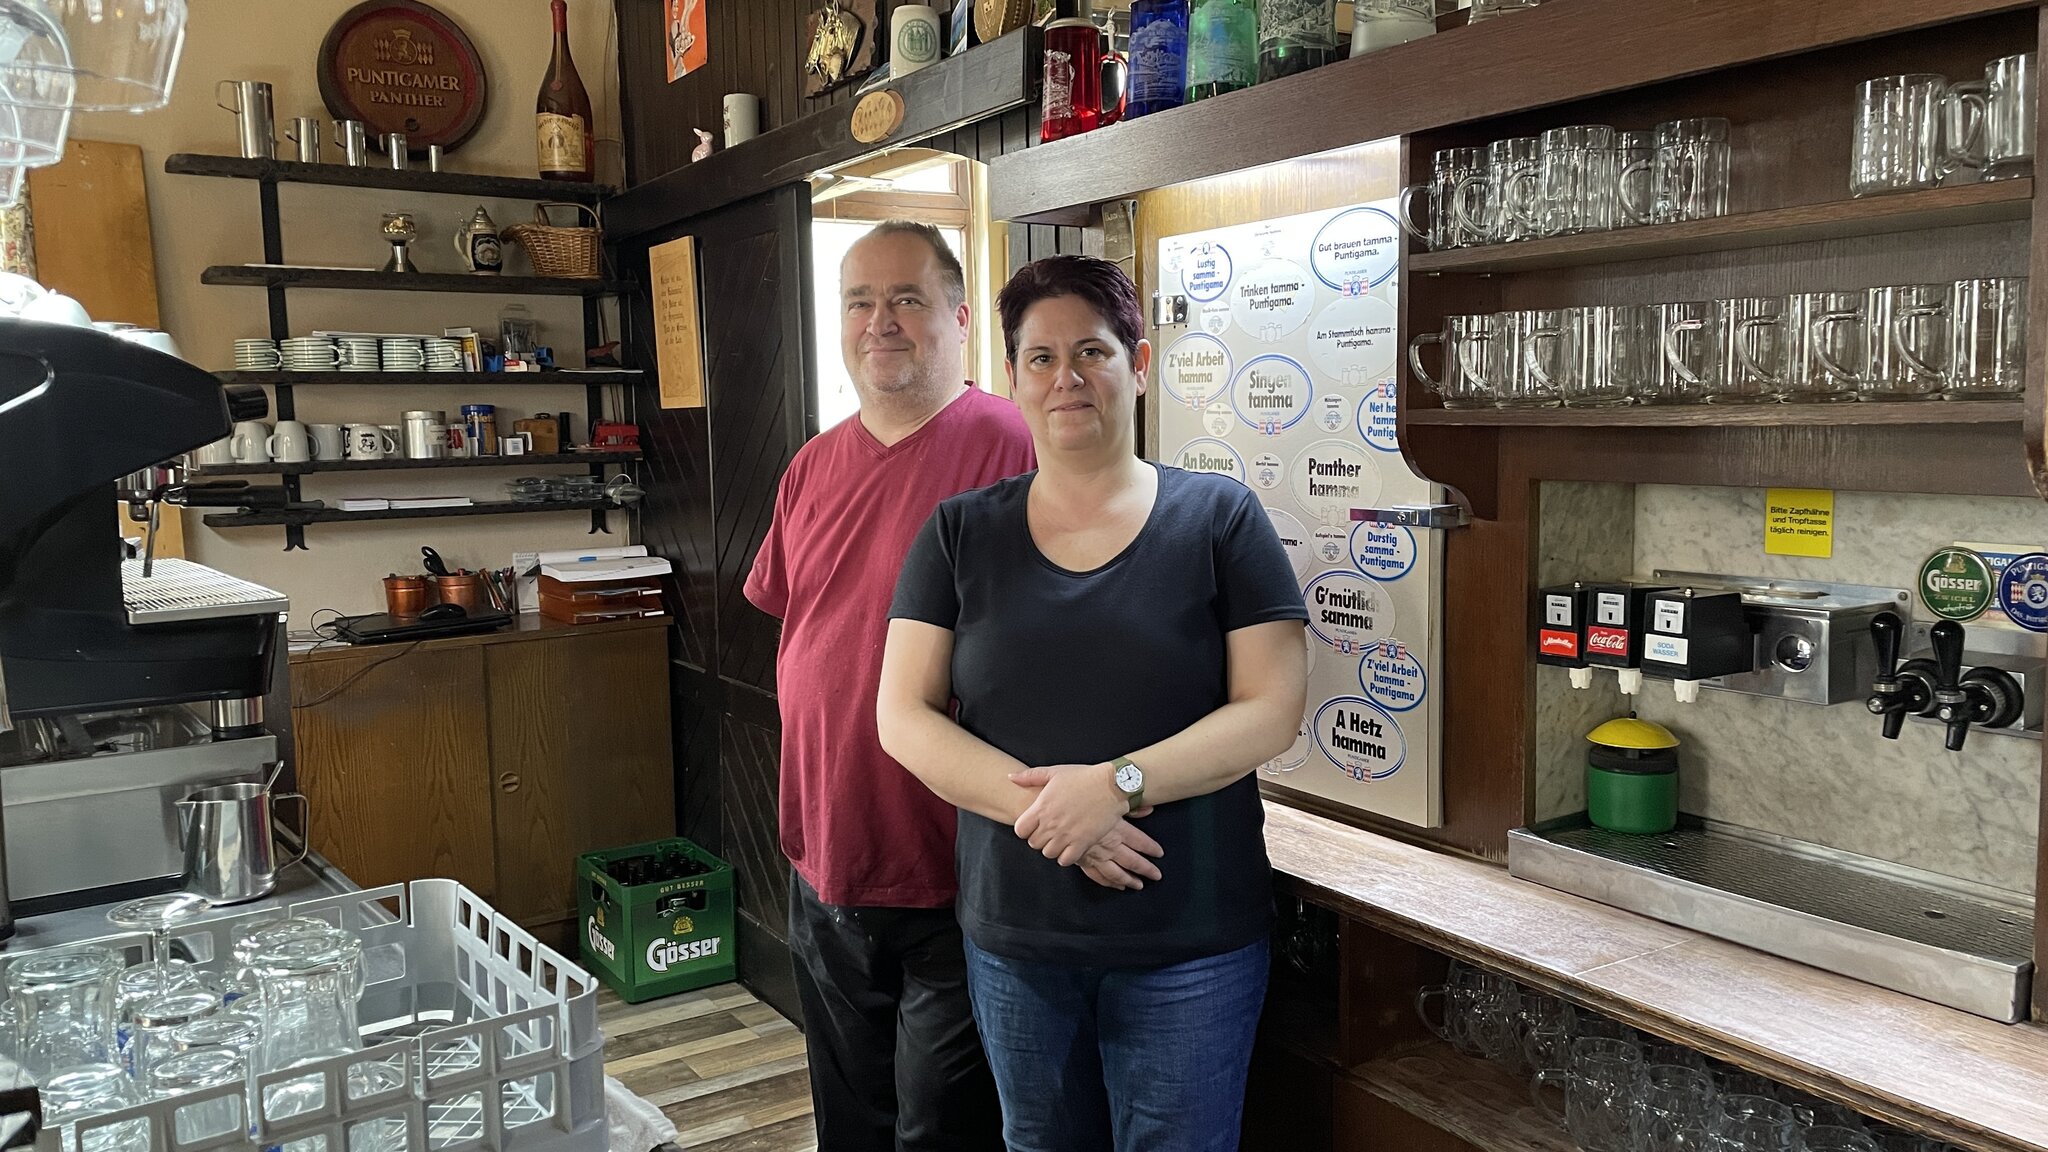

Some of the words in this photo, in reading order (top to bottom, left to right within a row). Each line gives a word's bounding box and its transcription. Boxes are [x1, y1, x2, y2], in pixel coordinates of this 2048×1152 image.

[347, 67, 461, 91] PUNTIGAMER
[370, 90, 444, 107] PANTHER
[1318, 243, 1332, 252] Gut
[1333, 240, 1361, 250] brauen
[1363, 236, 1392, 246] tamma
[1334, 248, 1380, 260] Puntigama.
[1197, 258, 1216, 270] Lustig
[1193, 271, 1216, 280] samma
[1189, 280, 1224, 292] Puntigama
[1240, 283, 1269, 298] Trinken
[1270, 282, 1299, 294] tamma
[1249, 295, 1294, 311] Puntigama.
[1316, 331, 1327, 340] Am
[1328, 326, 1364, 339] Stammtisch
[1365, 326, 1391, 336] hamma
[1336, 337, 1374, 350] Puntigama.
[1169, 351, 1194, 368] Z'viel
[1196, 350, 1224, 367] Arbeit
[1178, 368, 1213, 384] hamma
[1249, 369, 1292, 394] Singen
[1248, 391, 1293, 409] tamma
[1369, 402, 1384, 413] Net
[1367, 426, 1398, 440] Puntig
[1183, 452, 1198, 470] An
[1200, 453, 1233, 471] Bonus
[1308, 458, 1361, 477] Panther
[1309, 478, 1359, 498] hamma
[1771, 506, 1788, 514] Bitte
[1789, 507, 1830, 516] Zapfhähne
[1788, 516, 1826, 526] Tropftasse
[1368, 532, 1397, 547] Durstig
[1770, 526, 1794, 534] täglich
[1797, 528, 1829, 537] reinigen.
[1365, 545, 1394, 555] samma
[1360, 554, 1404, 570] Puntigama
[1927, 569, 1983, 592] Gösser
[1934, 594, 1976, 603] ZWICKL
[1321, 609, 1373, 630] samma
[1652, 648, 1679, 657] WASSER
[1657, 642, 1675, 650] SODA
[1367, 659, 1389, 672] Z'viel
[1391, 663, 1418, 677] Arbeit
[1374, 671, 1404, 687] hamma
[1370, 683, 1415, 701] Puntigama
[1336, 709, 1346, 729] A
[1350, 712, 1383, 738] Hetz
[1332, 727, 1386, 760] hamma
[660, 885, 673, 893] GUT
[677, 880, 704, 890] BESSER
[588, 915, 615, 961] Gösser
[646, 937, 721, 972] Gösser
